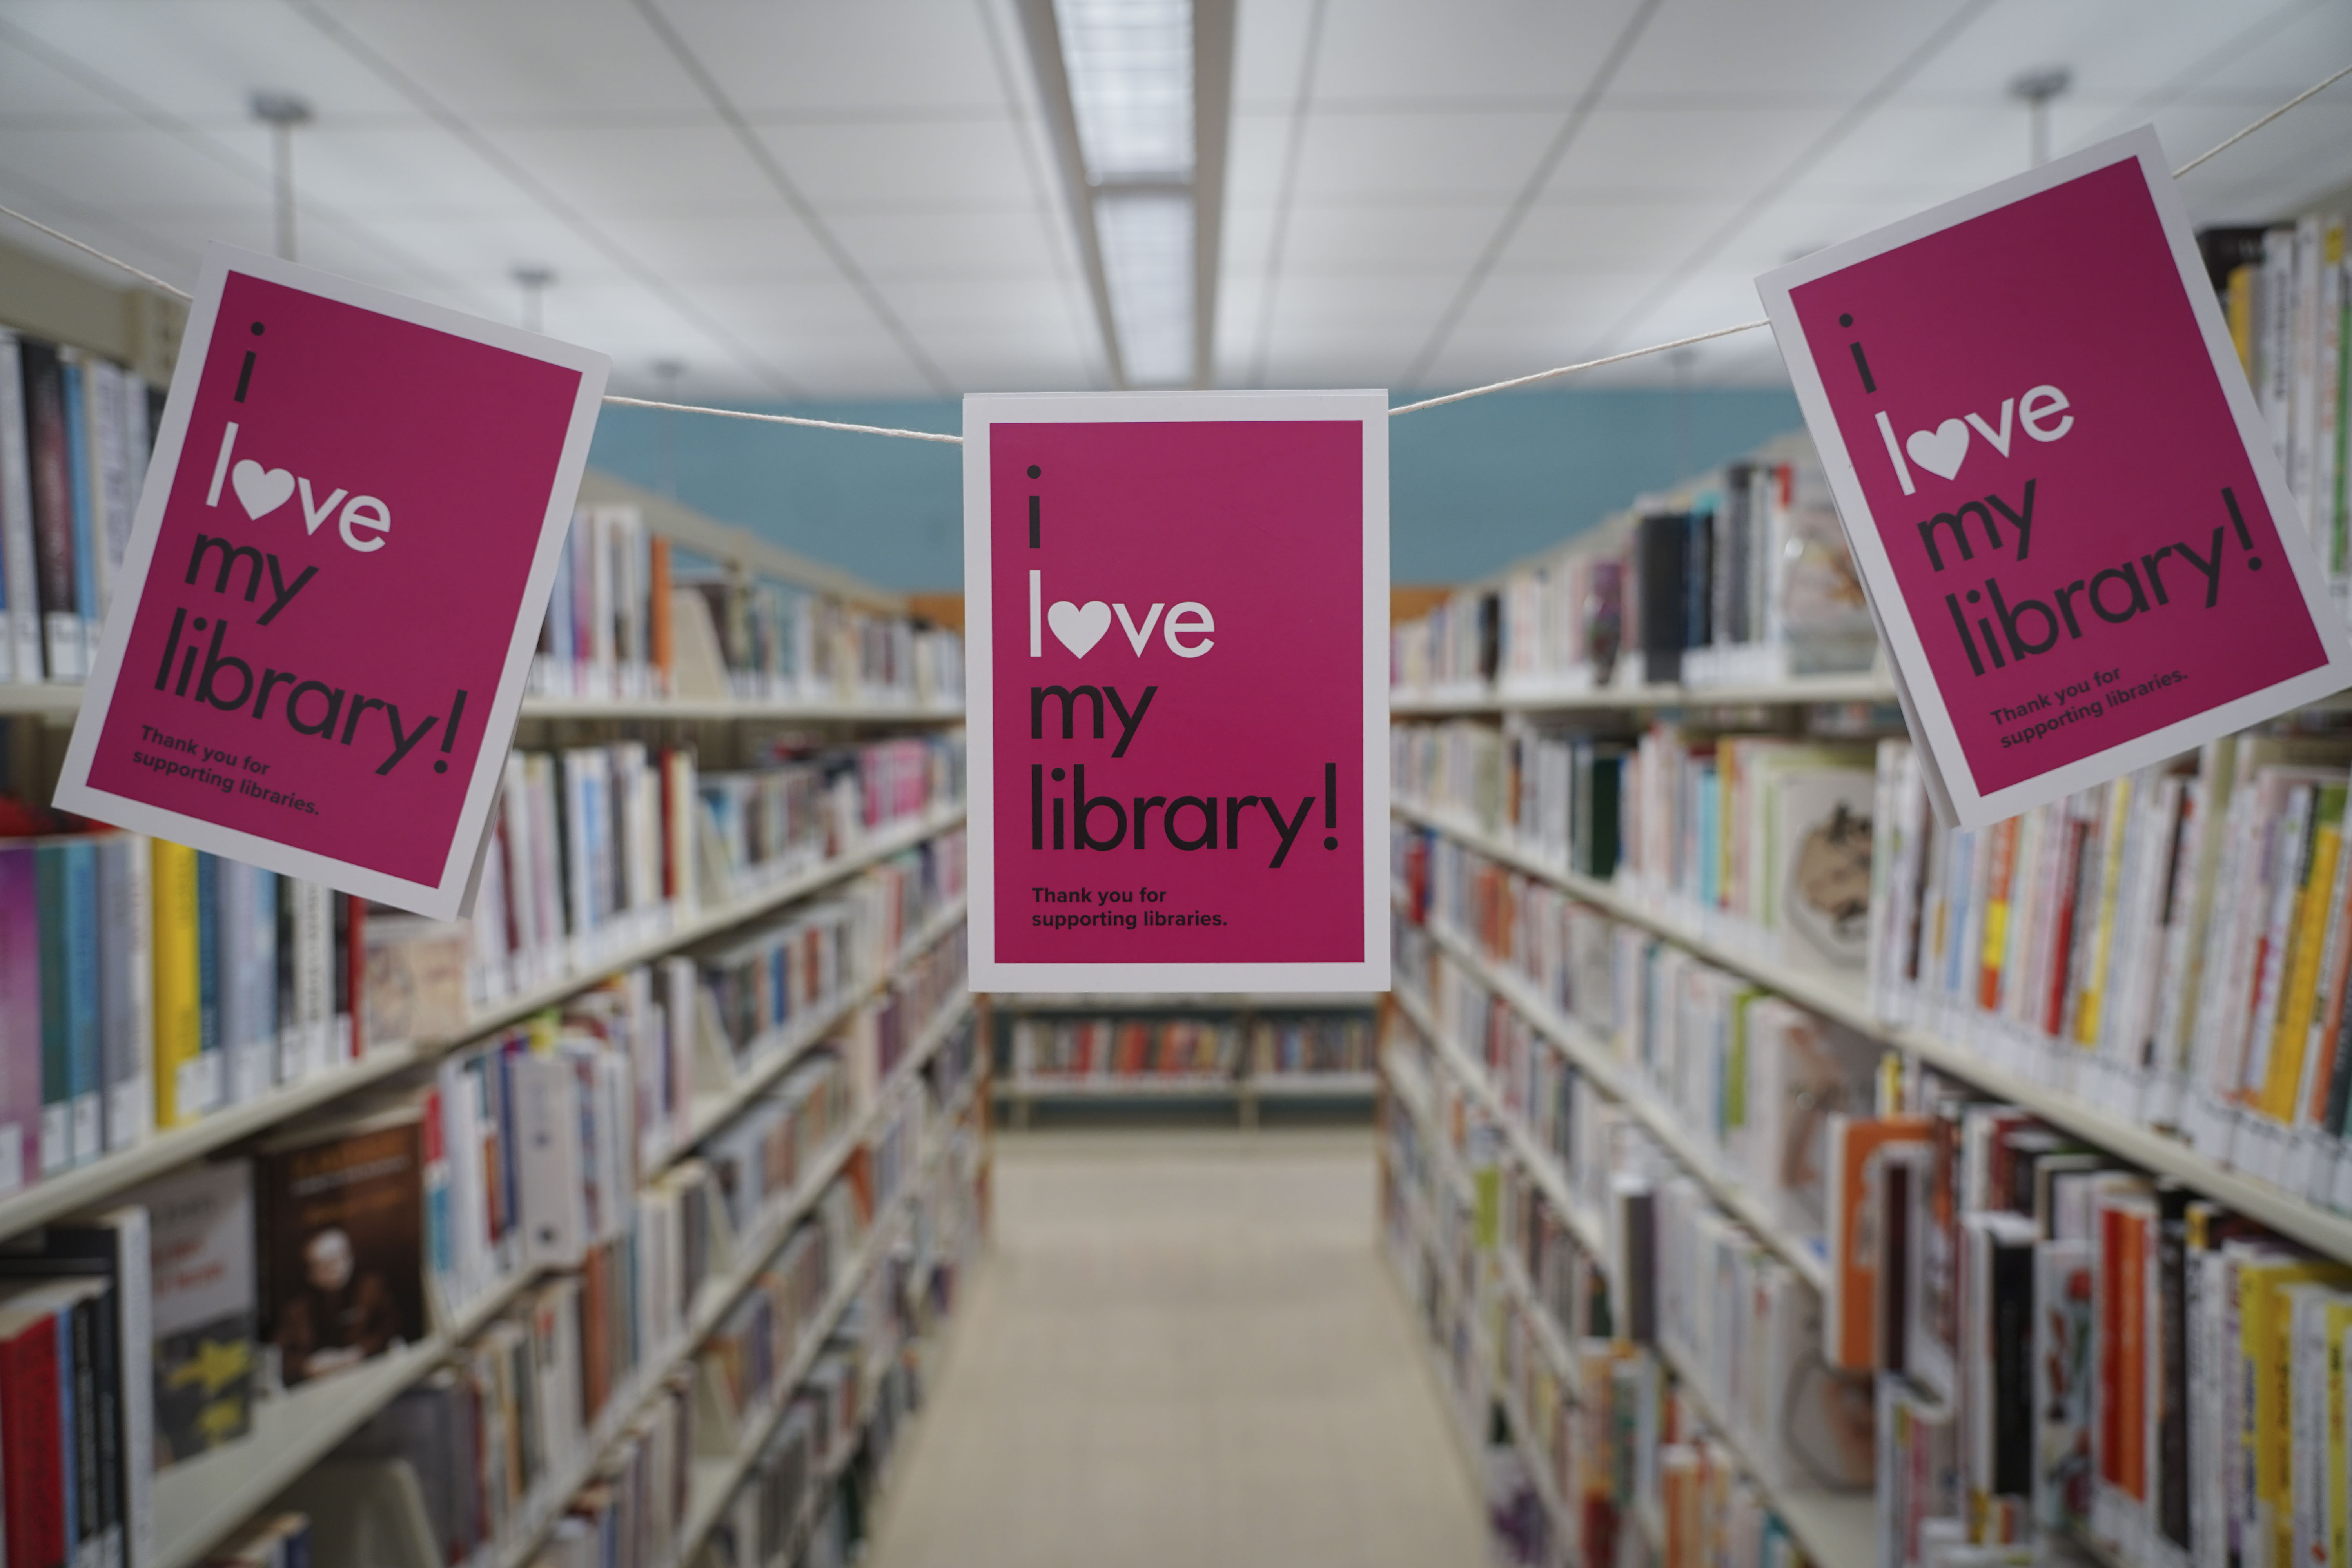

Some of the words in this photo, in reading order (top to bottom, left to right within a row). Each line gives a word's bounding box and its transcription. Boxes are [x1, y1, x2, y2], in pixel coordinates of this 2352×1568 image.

[1916, 478, 2036, 572] my
[185, 532, 319, 626] my
[1945, 486, 2262, 677] library!
[155, 607, 468, 776] library!
[1031, 684, 1158, 758] my
[1990, 693, 2051, 726] Thank
[2053, 680, 2091, 706] you
[2093, 668, 2122, 688] for
[2000, 701, 2103, 748] supporting
[2105, 670, 2188, 708] libraries.
[132, 750, 234, 793] supporting
[239, 779, 319, 815] libraries.
[141, 724, 198, 755] Thank
[201, 747, 238, 767] you
[242, 756, 270, 775] for
[1032, 762, 1338, 869] library!
[1032, 887, 1092, 903] Thank
[1098, 891, 1133, 907] you
[1139, 886, 1167, 902] for
[1032, 911, 1137, 930] supporting
[1143, 910, 1228, 926] libraries.
